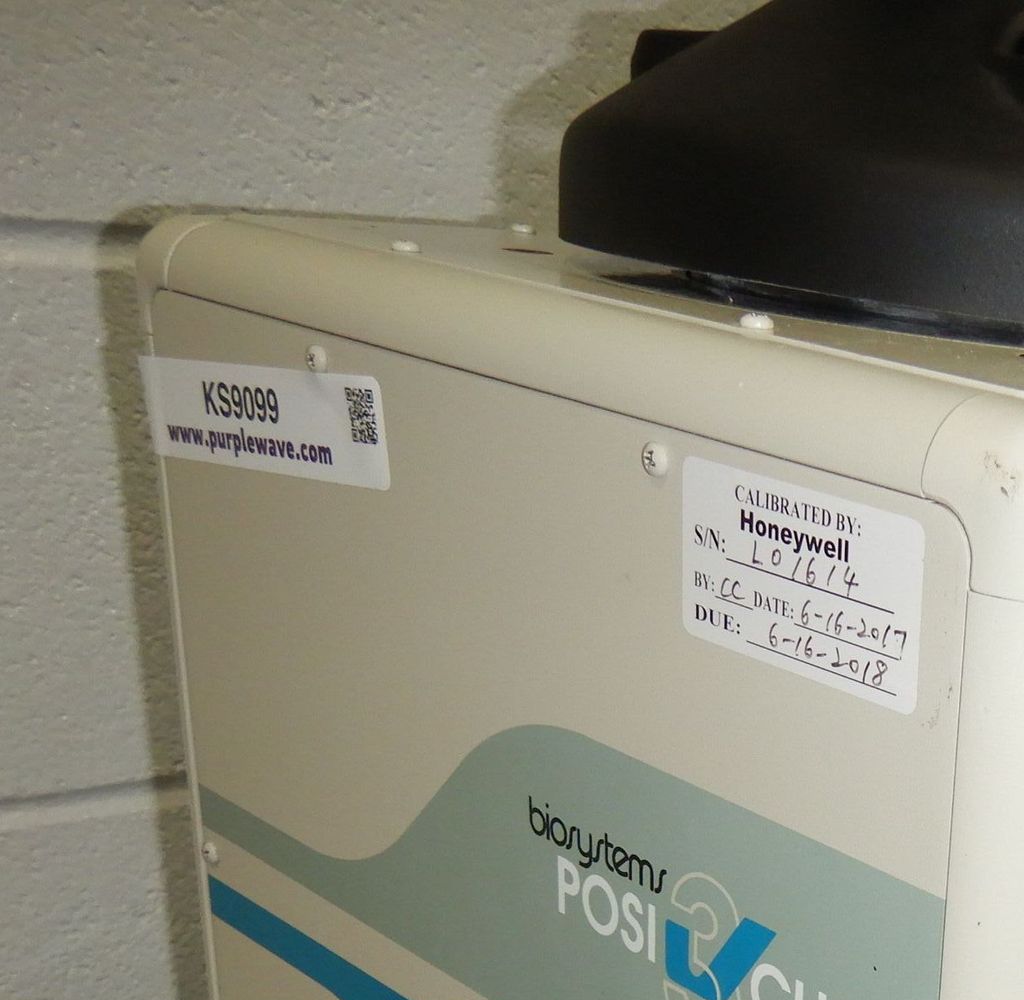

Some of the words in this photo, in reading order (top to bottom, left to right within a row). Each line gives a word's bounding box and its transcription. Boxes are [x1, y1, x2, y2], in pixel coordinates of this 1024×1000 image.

[202, 380, 280, 424] KS9099
[167, 424, 333, 466] www.purplewave.com
[734, 485, 832, 527] CALIBRATED
[836, 513, 862, 537] BY:
[694, 524, 726, 553] S/N:
[740, 509, 850, 563] Honeywell
[694, 570, 715, 592] BY:
[753, 591, 794, 619] DATE:
[695, 603, 741, 635] DUE:
[800, 599, 907, 661] 6-16-2017
[769, 622, 888, 686] 6-16-2018
[528, 795, 667, 894] biosystems
[557, 855, 656, 963] POSI
